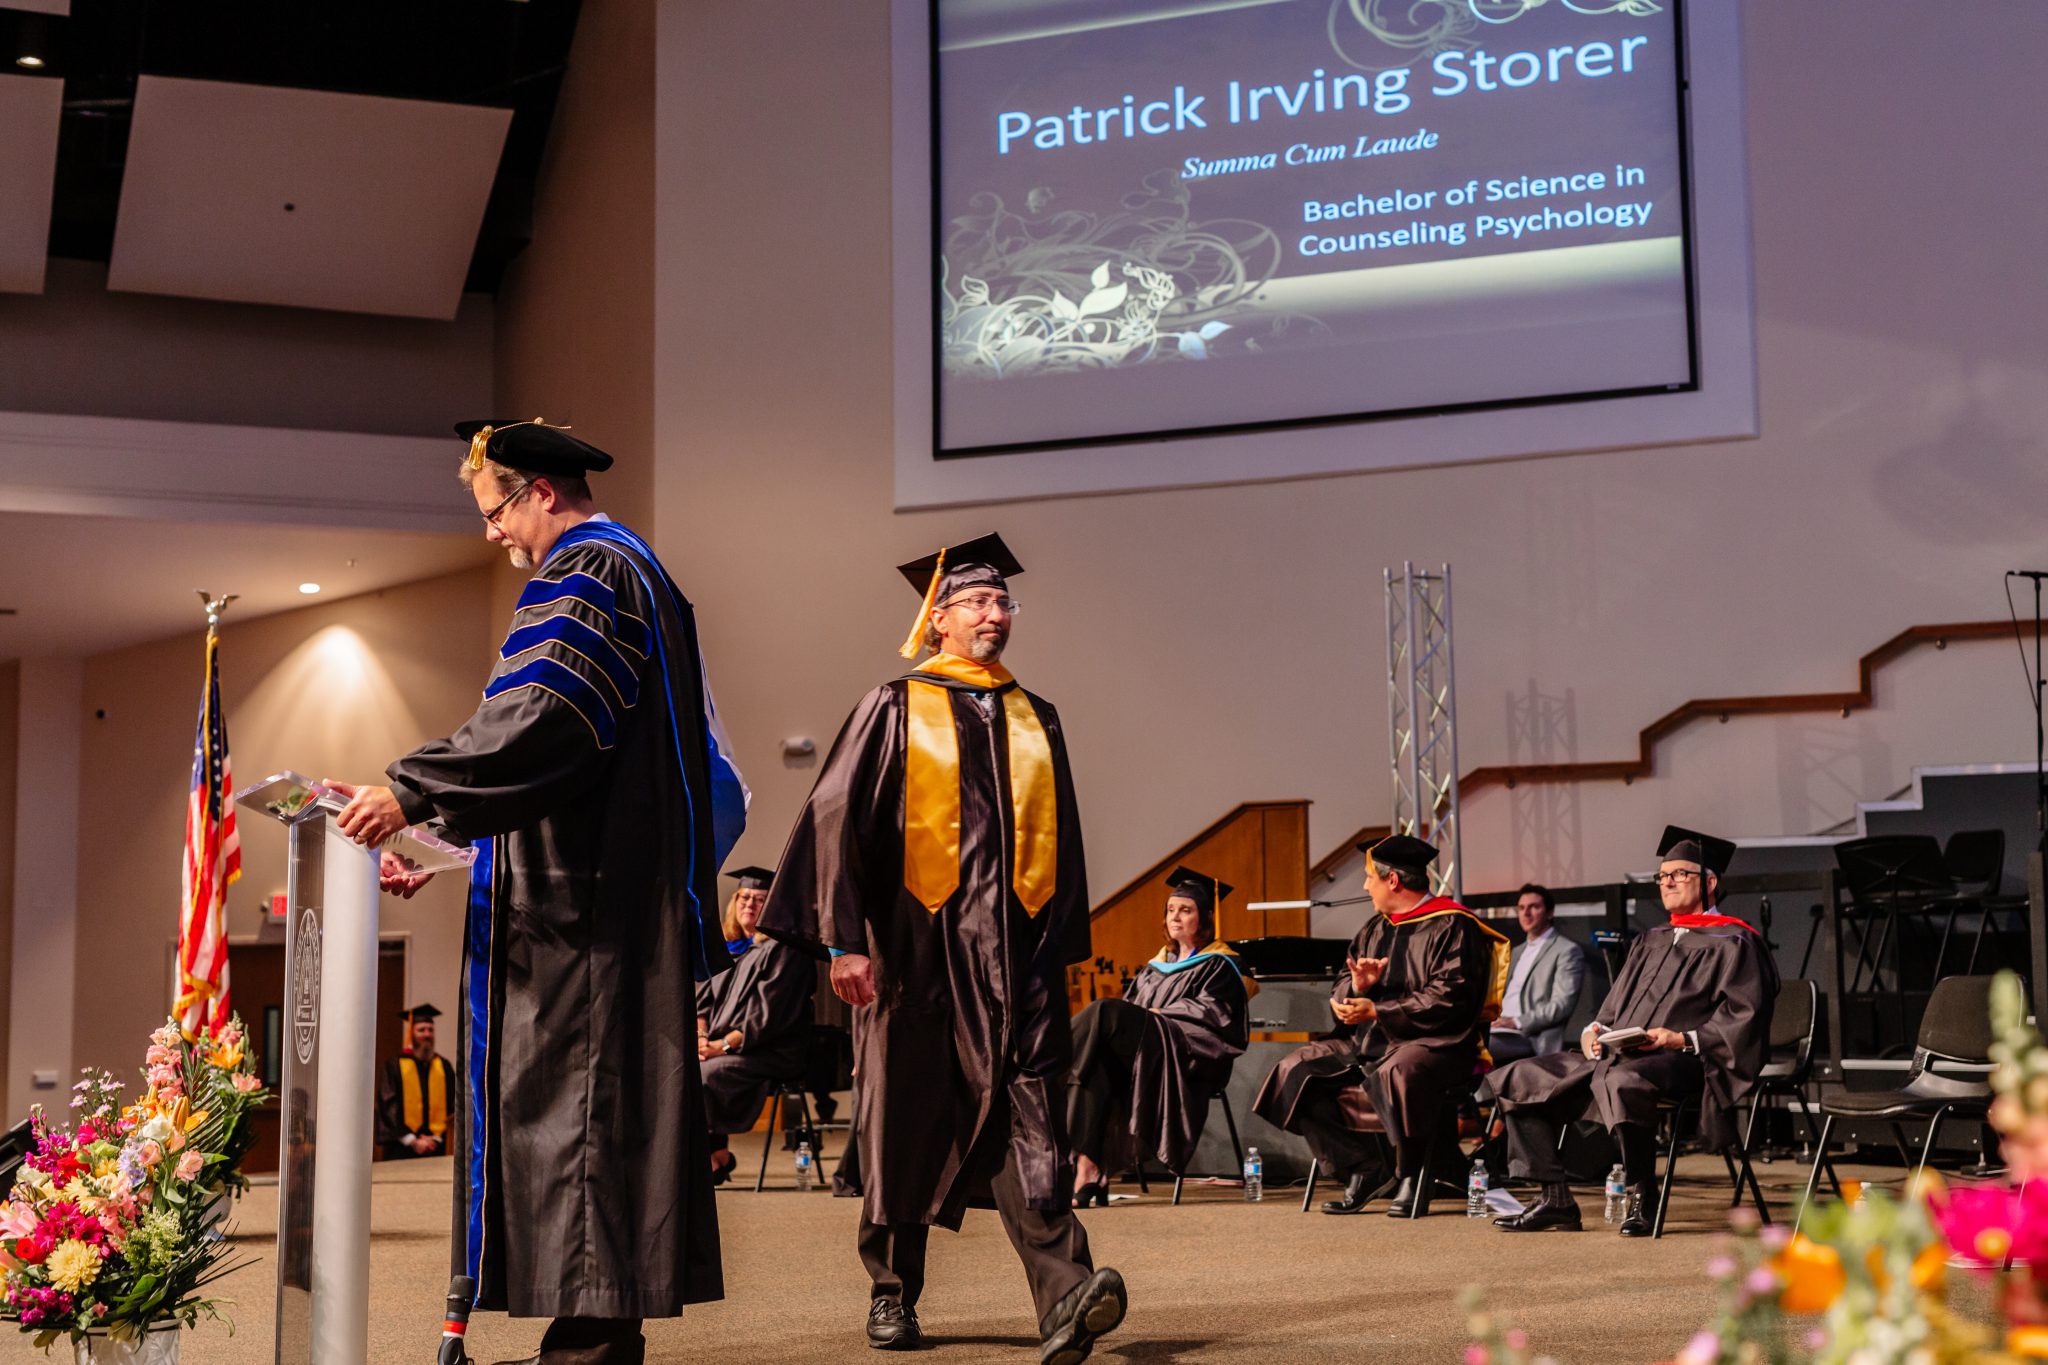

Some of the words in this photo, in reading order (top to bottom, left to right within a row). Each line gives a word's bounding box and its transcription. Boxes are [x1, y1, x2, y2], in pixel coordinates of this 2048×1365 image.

[998, 86, 1207, 154] Patrick
[1229, 68, 1411, 124] Irving
[1432, 35, 1648, 97] Storer
[1181, 153, 1277, 180] Summa
[1284, 143, 1347, 166] Cum
[1352, 128, 1439, 158] Laude
[1304, 190, 1437, 222] Bachelor
[1445, 180, 1479, 206] of
[1485, 172, 1606, 202] Science
[1616, 164, 1645, 187] in
[1298, 221, 1467, 256] Counseling
[1476, 201, 1653, 239] Psychology
